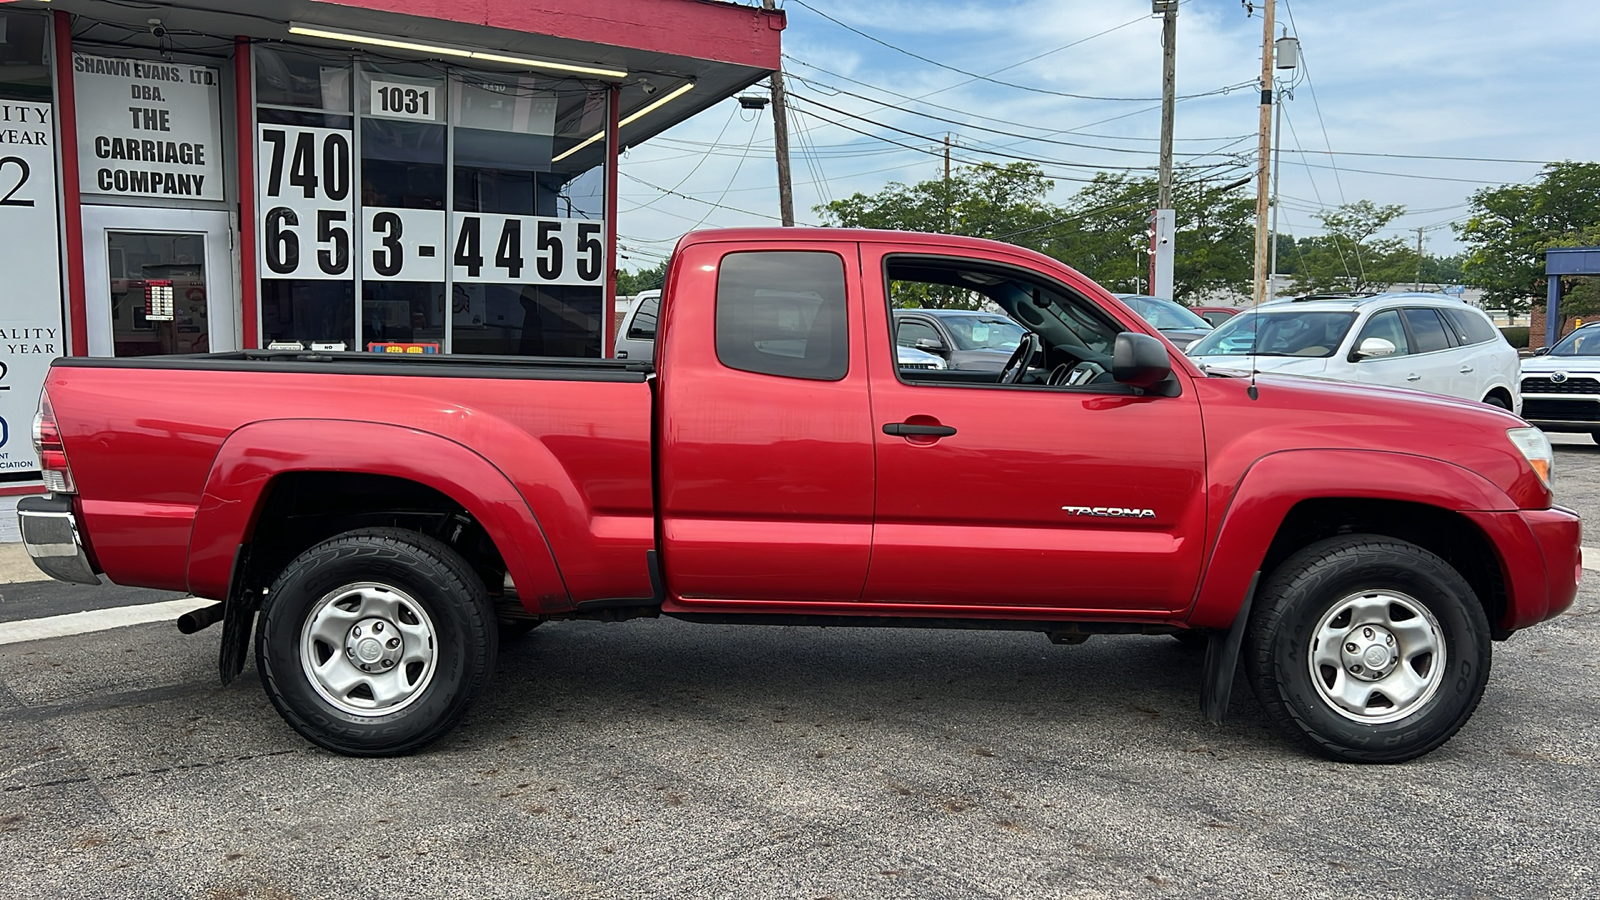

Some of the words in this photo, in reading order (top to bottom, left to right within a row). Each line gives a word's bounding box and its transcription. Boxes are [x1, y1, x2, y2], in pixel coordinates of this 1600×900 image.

[75, 57, 130, 77] SHAWN
[134, 63, 183, 83] EVANS.
[190, 69, 217, 86] LTD.
[131, 84, 165, 102] DBA.
[378, 86, 429, 115] 1031
[129, 107, 170, 132] THE
[95, 136, 205, 165] CARRIAGE
[263, 129, 350, 201] 740
[97, 168, 205, 196] COMPANY
[7, 343, 55, 354] YEAR
[1061, 506, 1156, 518] TACOMA
